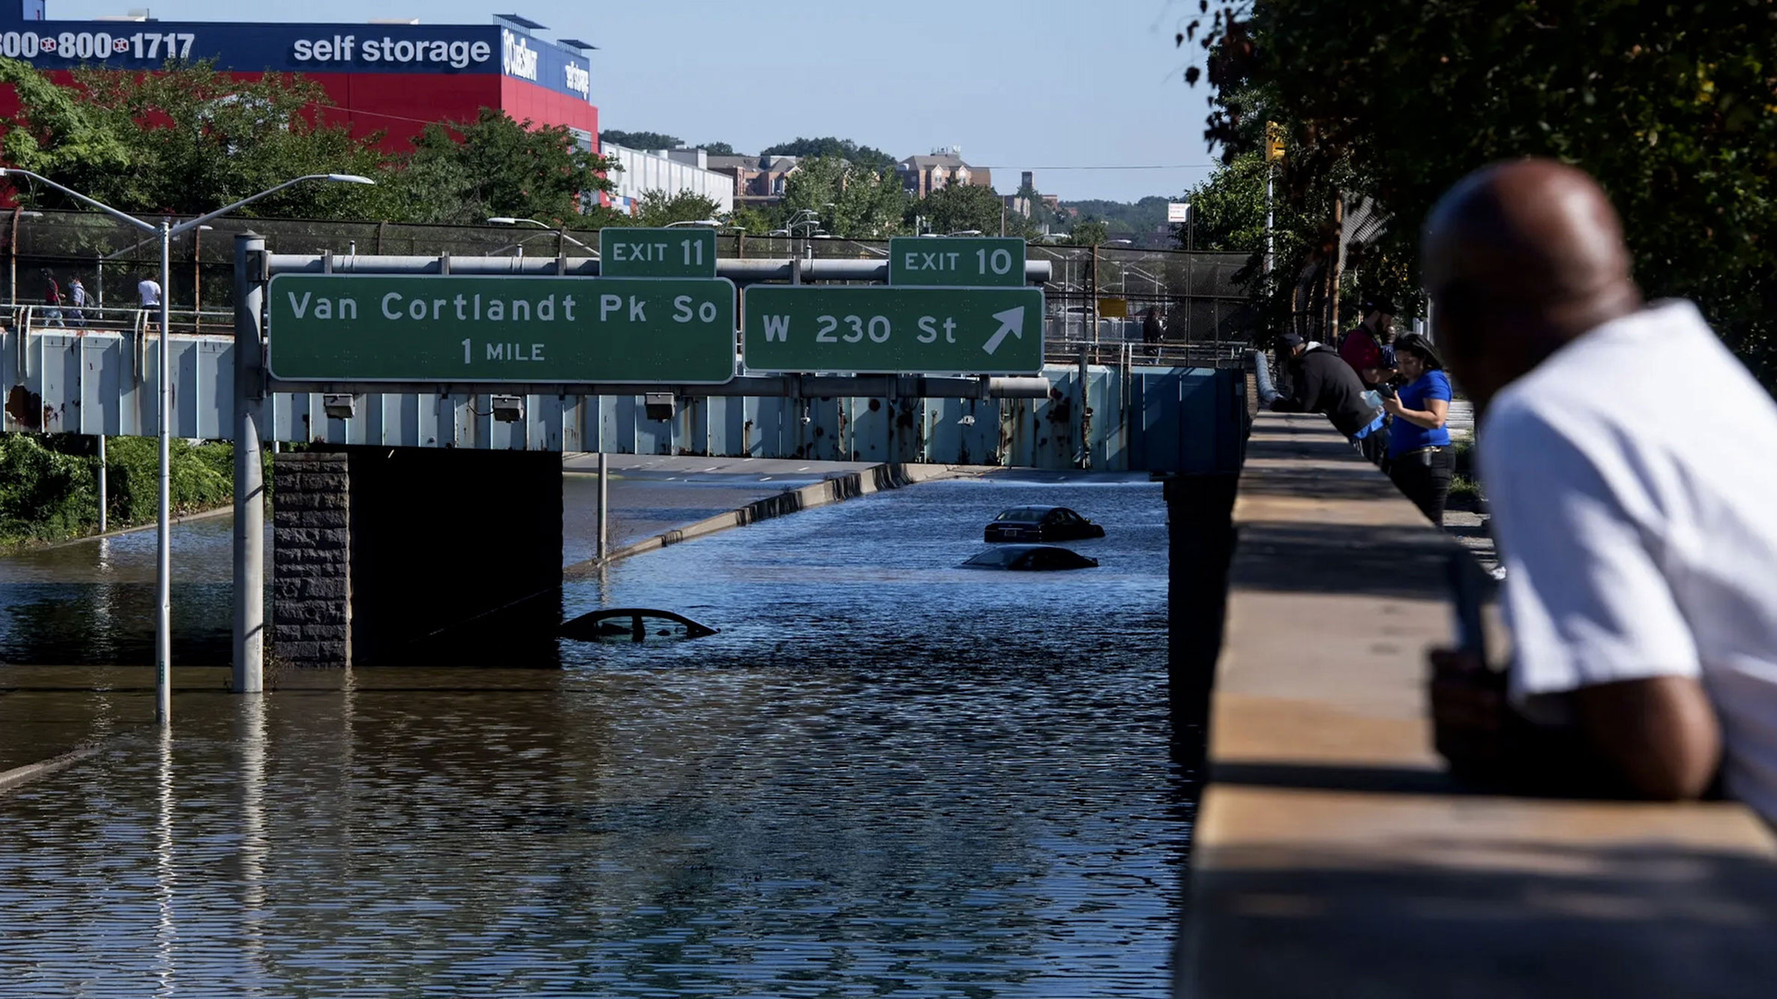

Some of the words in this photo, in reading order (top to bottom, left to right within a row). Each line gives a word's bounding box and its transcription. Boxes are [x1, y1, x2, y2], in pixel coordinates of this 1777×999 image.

[0, 32, 39, 57] 00
[58, 33, 112, 58] 800
[130, 33, 194, 58] 1717
[295, 36, 354, 60] self
[363, 37, 490, 68] storage
[614, 244, 667, 260] EXIT
[682, 240, 702, 264] 11
[906, 253, 959, 269] EXIT
[977, 249, 1011, 274] 10
[288, 292, 356, 318] Van
[382, 293, 575, 320] Cortlandt
[601, 295, 646, 321] Pk
[673, 296, 716, 322] So
[764, 316, 789, 341] W
[816, 316, 890, 342] 230
[917, 316, 955, 343] St
[462, 339, 470, 363] 1
[487, 344, 544, 360] MILE
